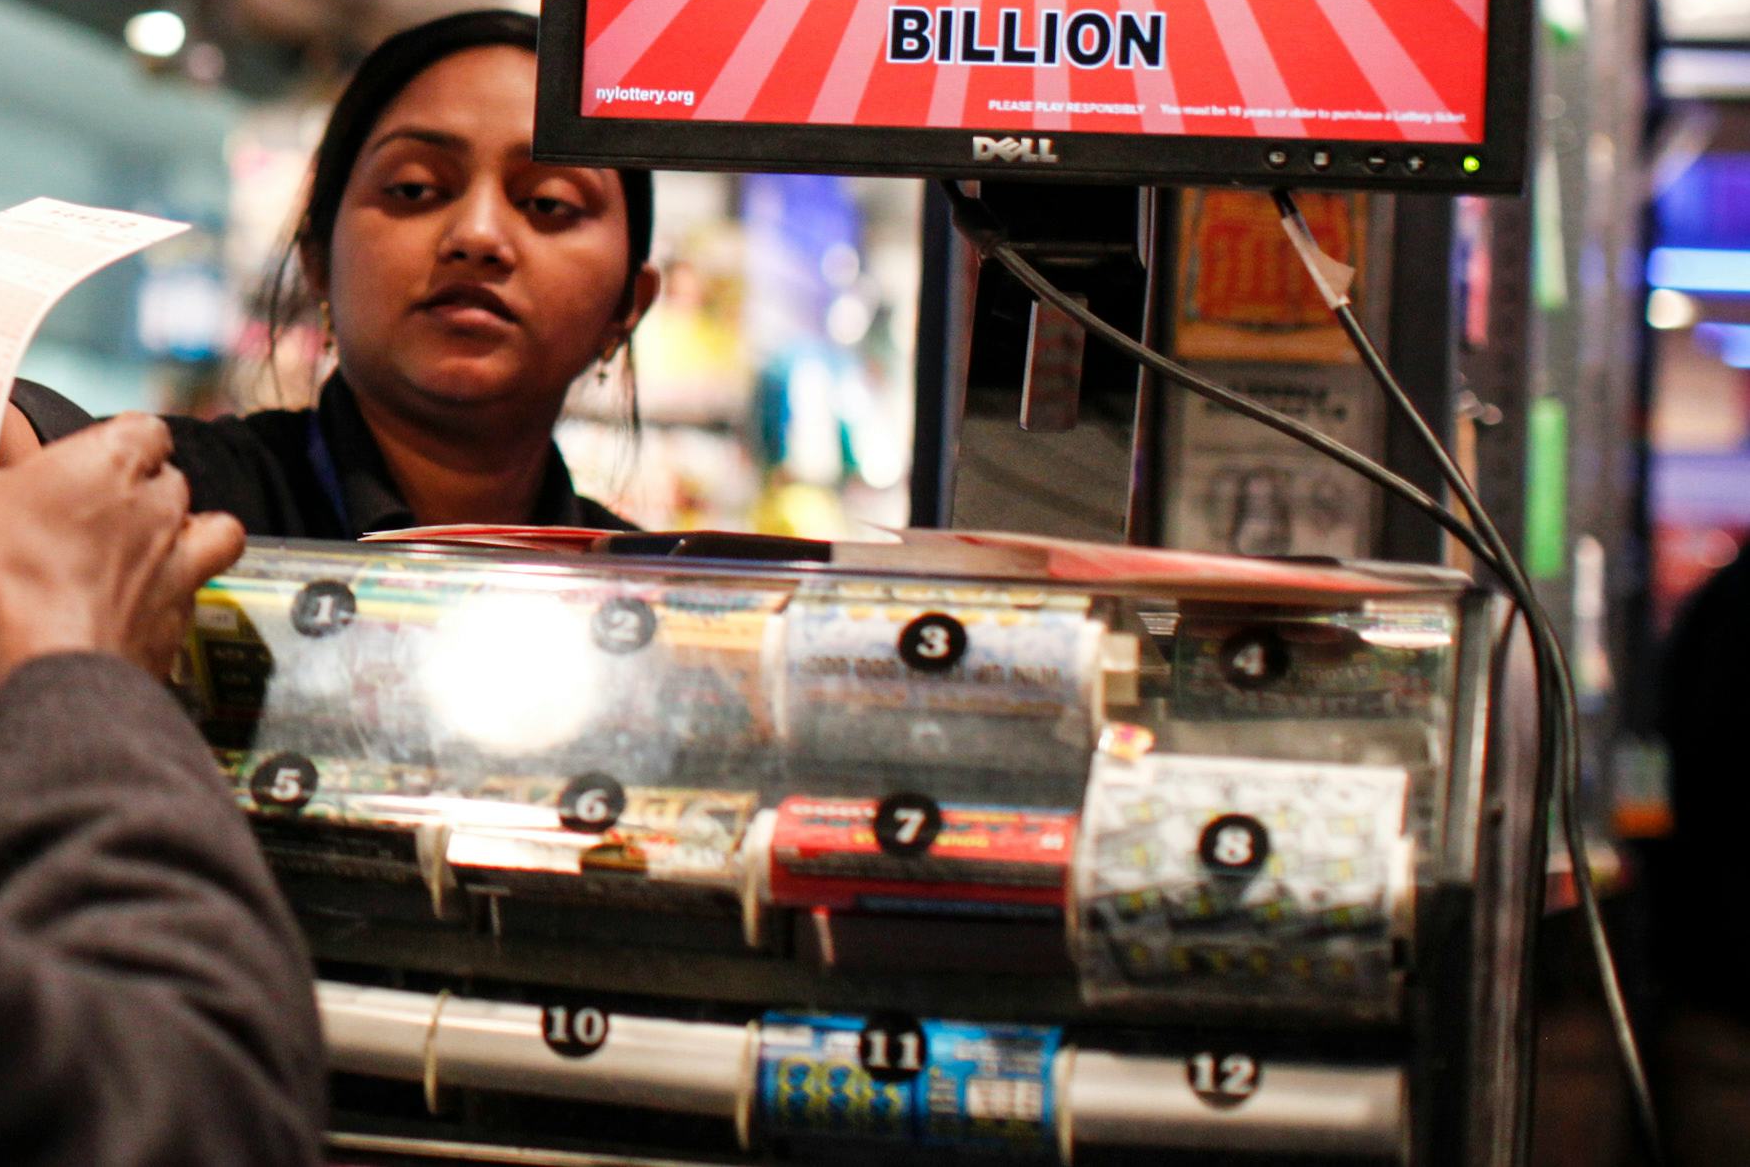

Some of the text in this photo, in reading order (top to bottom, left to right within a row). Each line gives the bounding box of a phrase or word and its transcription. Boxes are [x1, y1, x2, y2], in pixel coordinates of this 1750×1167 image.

[886, 6, 1167, 70] BILLION
[595, 85, 695, 106] nylottery.org
[988, 99, 1033, 112] PLEASE
[972, 135, 1059, 163] DELL
[916, 624, 950, 659] 3
[270, 768, 302, 801] 5
[575, 789, 609, 822] 6
[893, 808, 926, 844] 7
[1213, 824, 1253, 866] 8
[549, 1005, 606, 1044] 10
[866, 1031, 922, 1070] 11
[1194, 1051, 1254, 1093] 12
